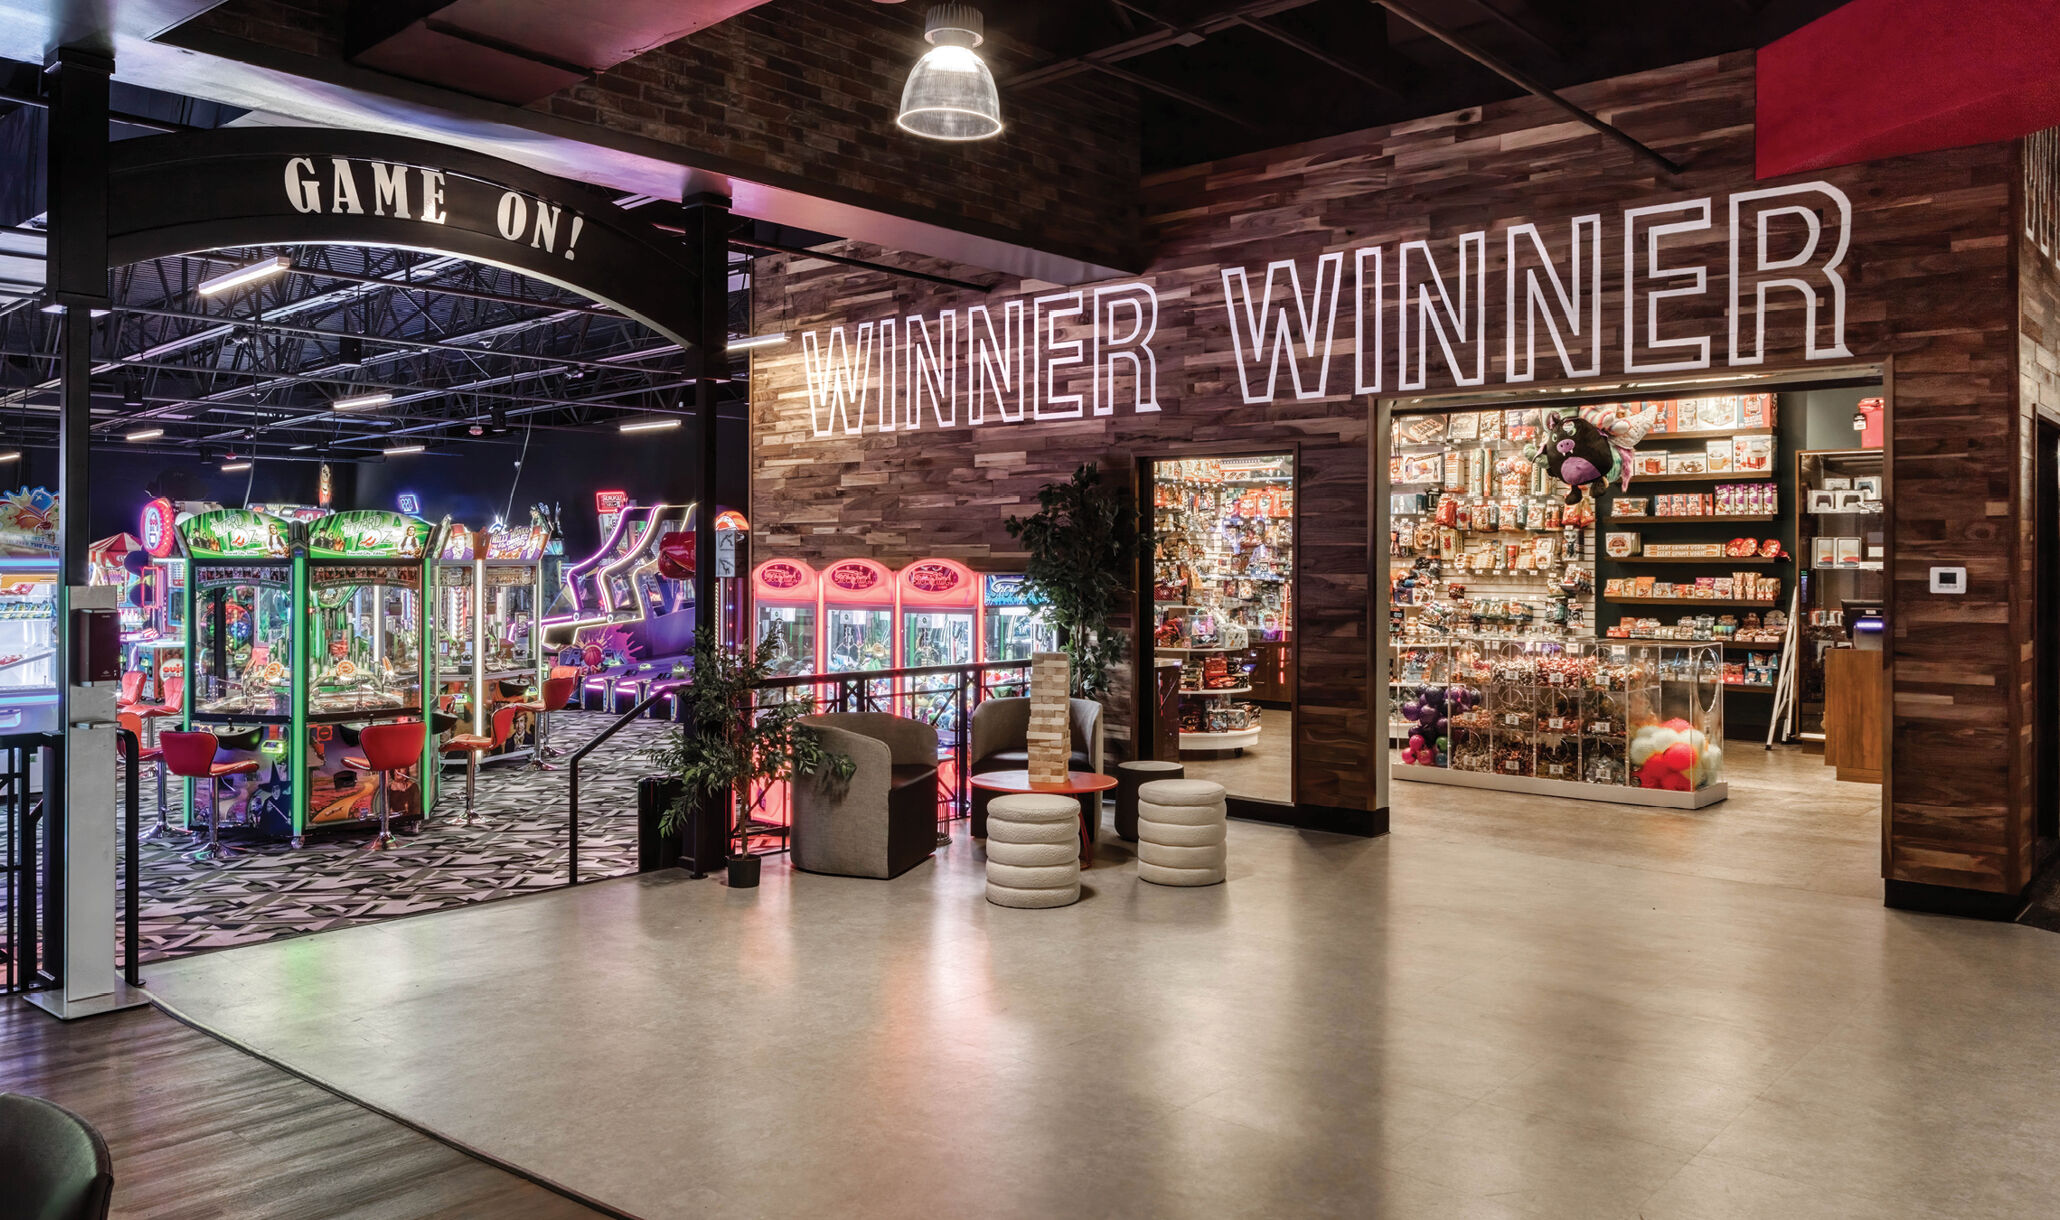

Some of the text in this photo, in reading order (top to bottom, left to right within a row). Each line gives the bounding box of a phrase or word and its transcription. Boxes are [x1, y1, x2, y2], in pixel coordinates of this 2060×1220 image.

[284, 156, 585, 262] GAME ON!
[1221, 180, 1854, 404] WINNER
[802, 282, 1162, 437] WINNER
[341, 515, 382, 538] WIZARD
